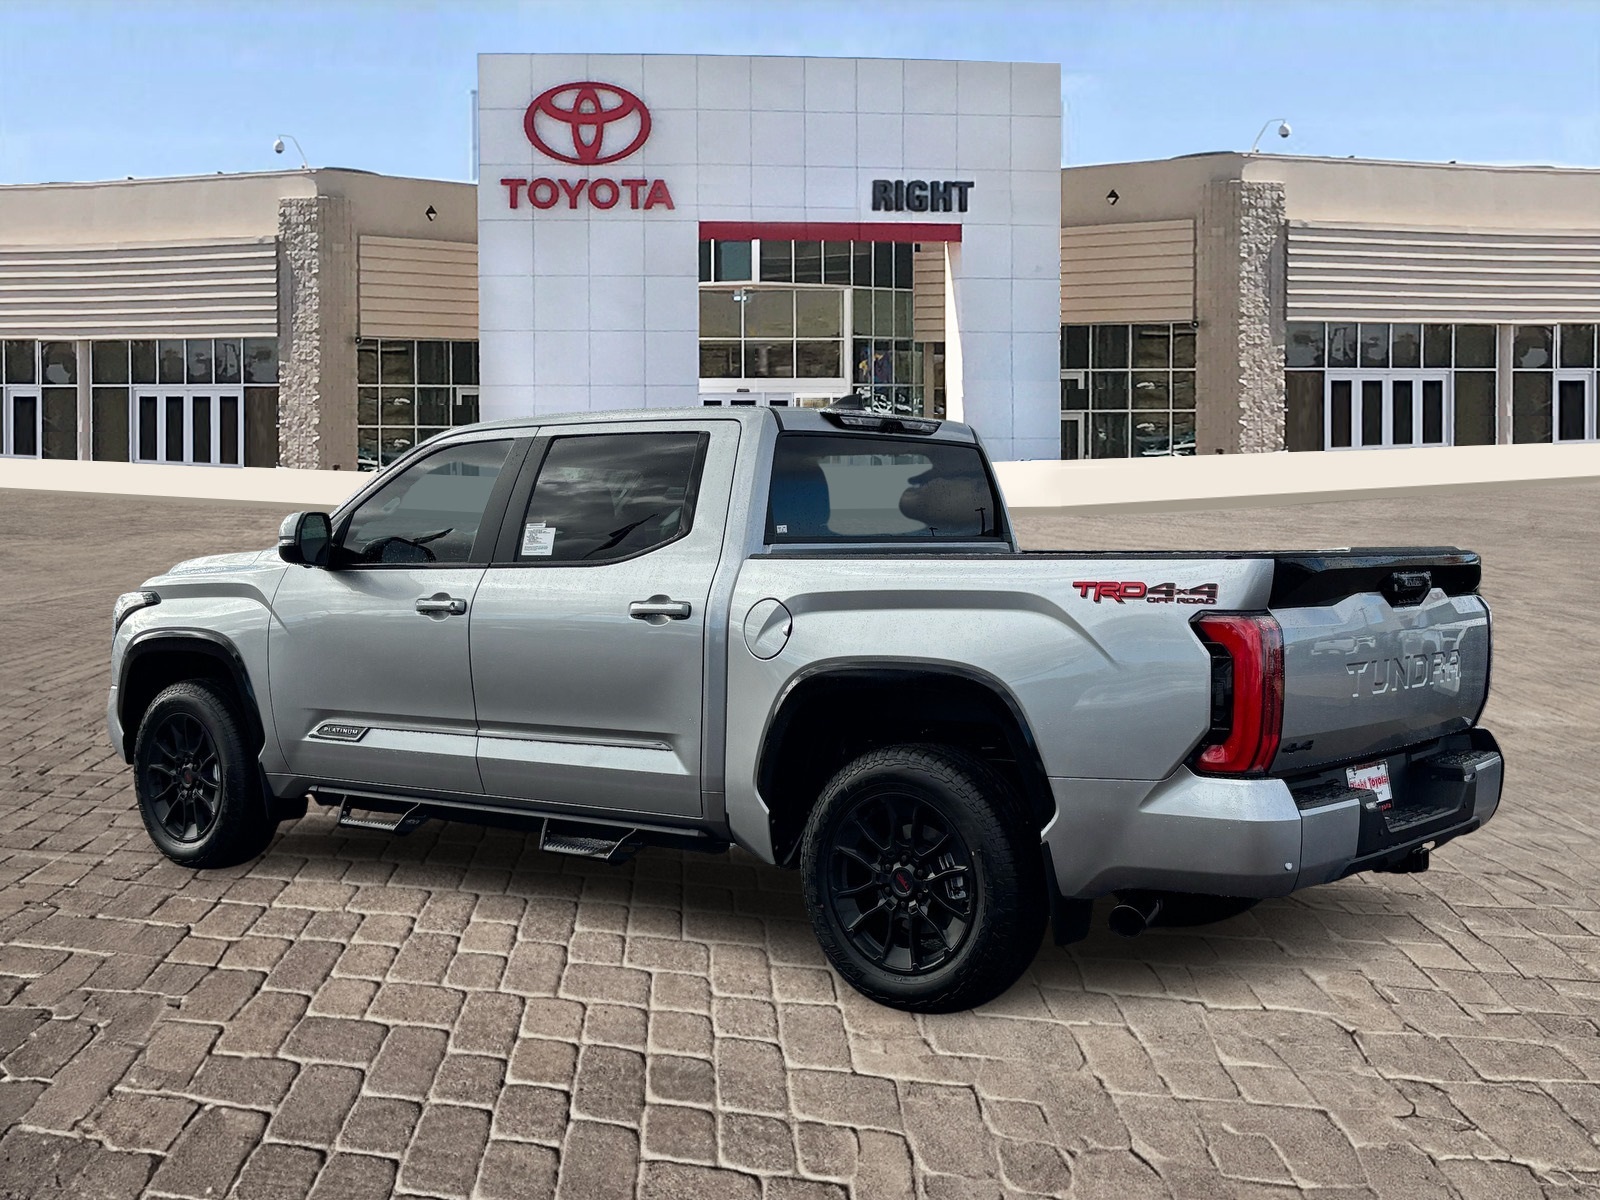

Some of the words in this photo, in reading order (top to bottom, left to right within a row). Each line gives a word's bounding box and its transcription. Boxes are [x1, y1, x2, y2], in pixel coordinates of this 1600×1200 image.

[500, 177, 676, 210] TOYOTA
[872, 179, 974, 212] RIGHT
[1073, 581, 1147, 604] TRD
[1346, 649, 1461, 698] TUNDRA
[323, 726, 358, 735] PLATINUM
